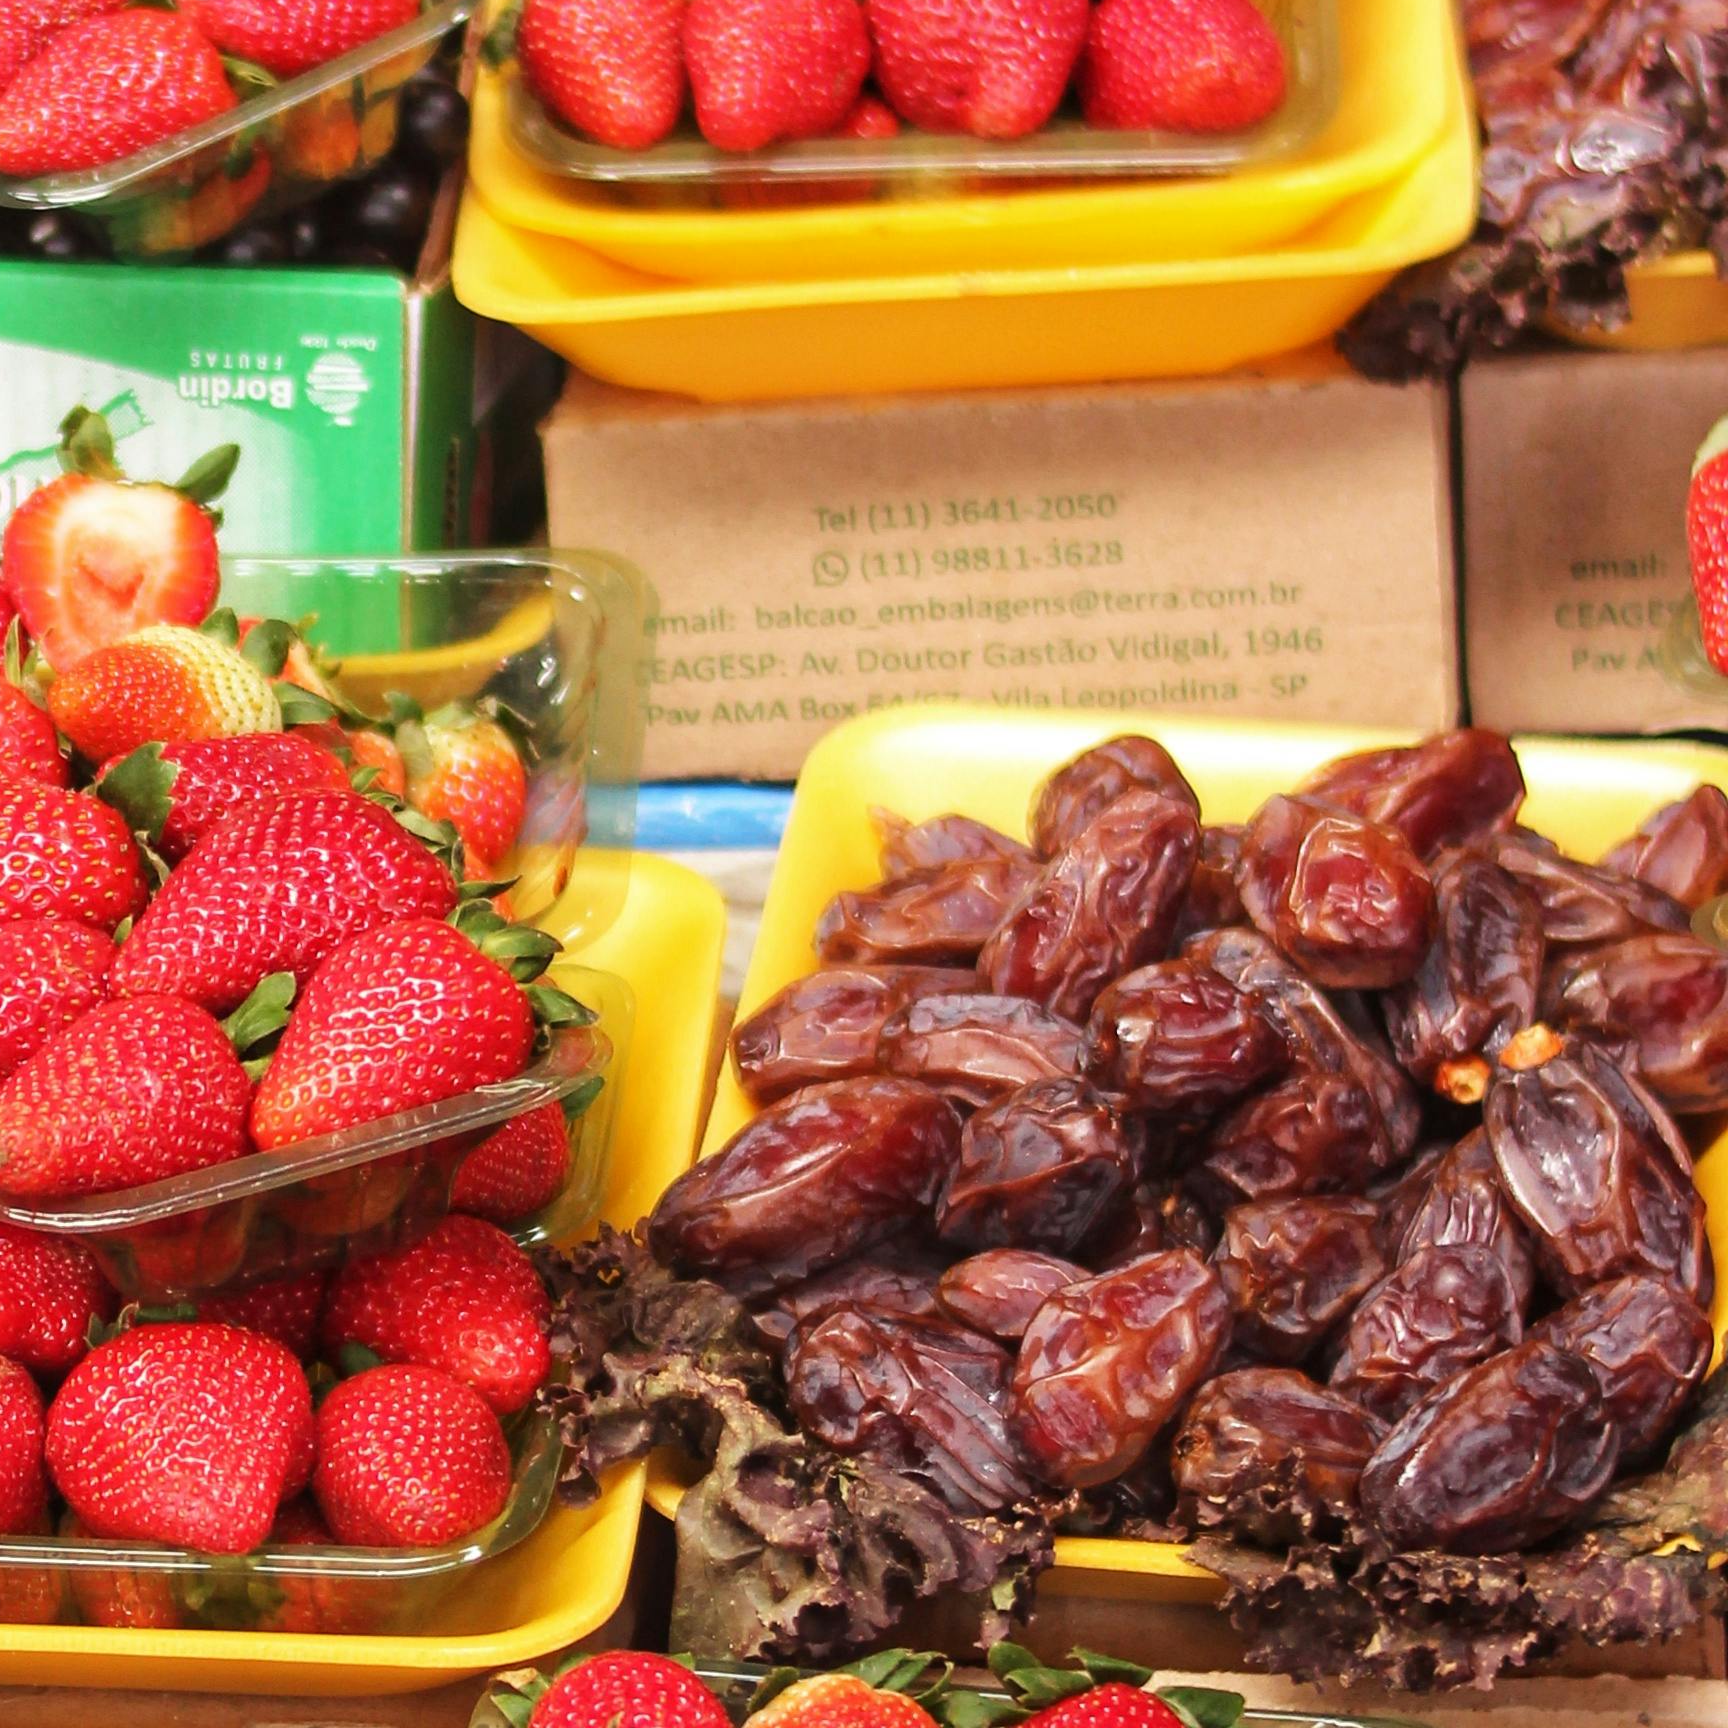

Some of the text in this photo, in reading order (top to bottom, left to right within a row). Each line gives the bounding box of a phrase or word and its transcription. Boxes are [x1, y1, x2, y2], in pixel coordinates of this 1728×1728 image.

[189, 351, 283, 370] FRUTAS
[177, 375, 294, 409] Bordin
[813, 493, 1117, 534] Tel (11) 3641-2050
[860, 540, 1123, 582] (11) 98811-3628
[800, 650, 843, 675] Av.
[856, 646, 971, 673] Doutor
[983, 638, 1097, 668] Gastão
[1107, 631, 1229, 663] Vidigal,
[1245, 627, 1323, 657] 1946
[712, 698, 789, 724] AMA
[1271, 674, 1308, 700] SP
